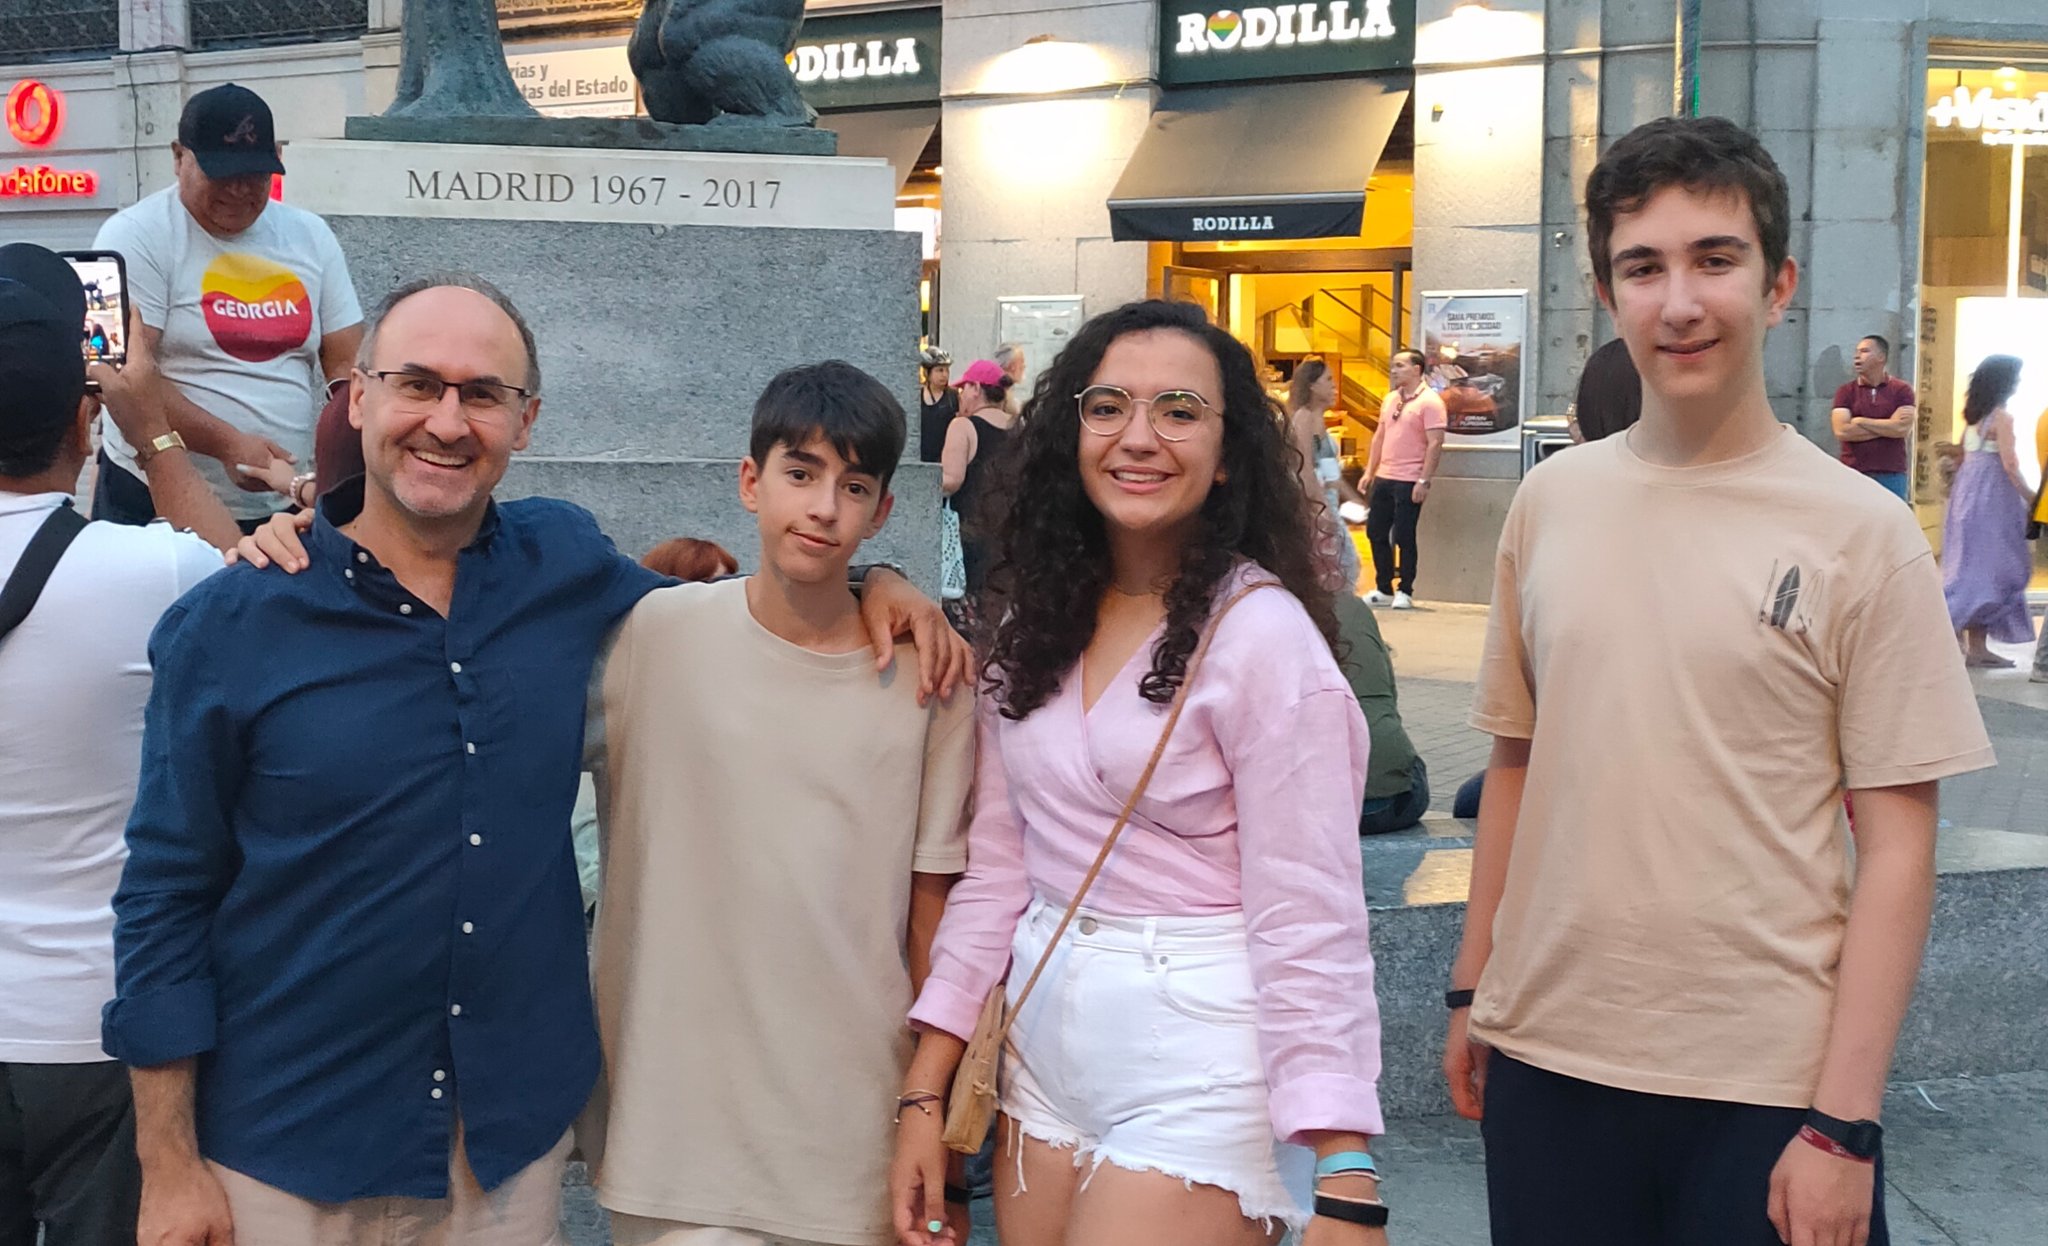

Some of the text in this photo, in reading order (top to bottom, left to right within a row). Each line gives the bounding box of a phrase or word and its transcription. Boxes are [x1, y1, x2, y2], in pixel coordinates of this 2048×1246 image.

[1176, 0, 1396, 53] RODILLA
[540, 64, 549, 81] y
[786, 38, 920, 81] DILLA
[548, 79, 571, 98] del
[575, 75, 629, 96] Estado
[0, 166, 93, 195] dafone
[405, 169, 574, 203] MADRID
[590, 175, 667, 206] 1967
[702, 178, 782, 209] 2017
[1192, 215, 1275, 231] RODILLA
[212, 298, 299, 320] GEORGIA
